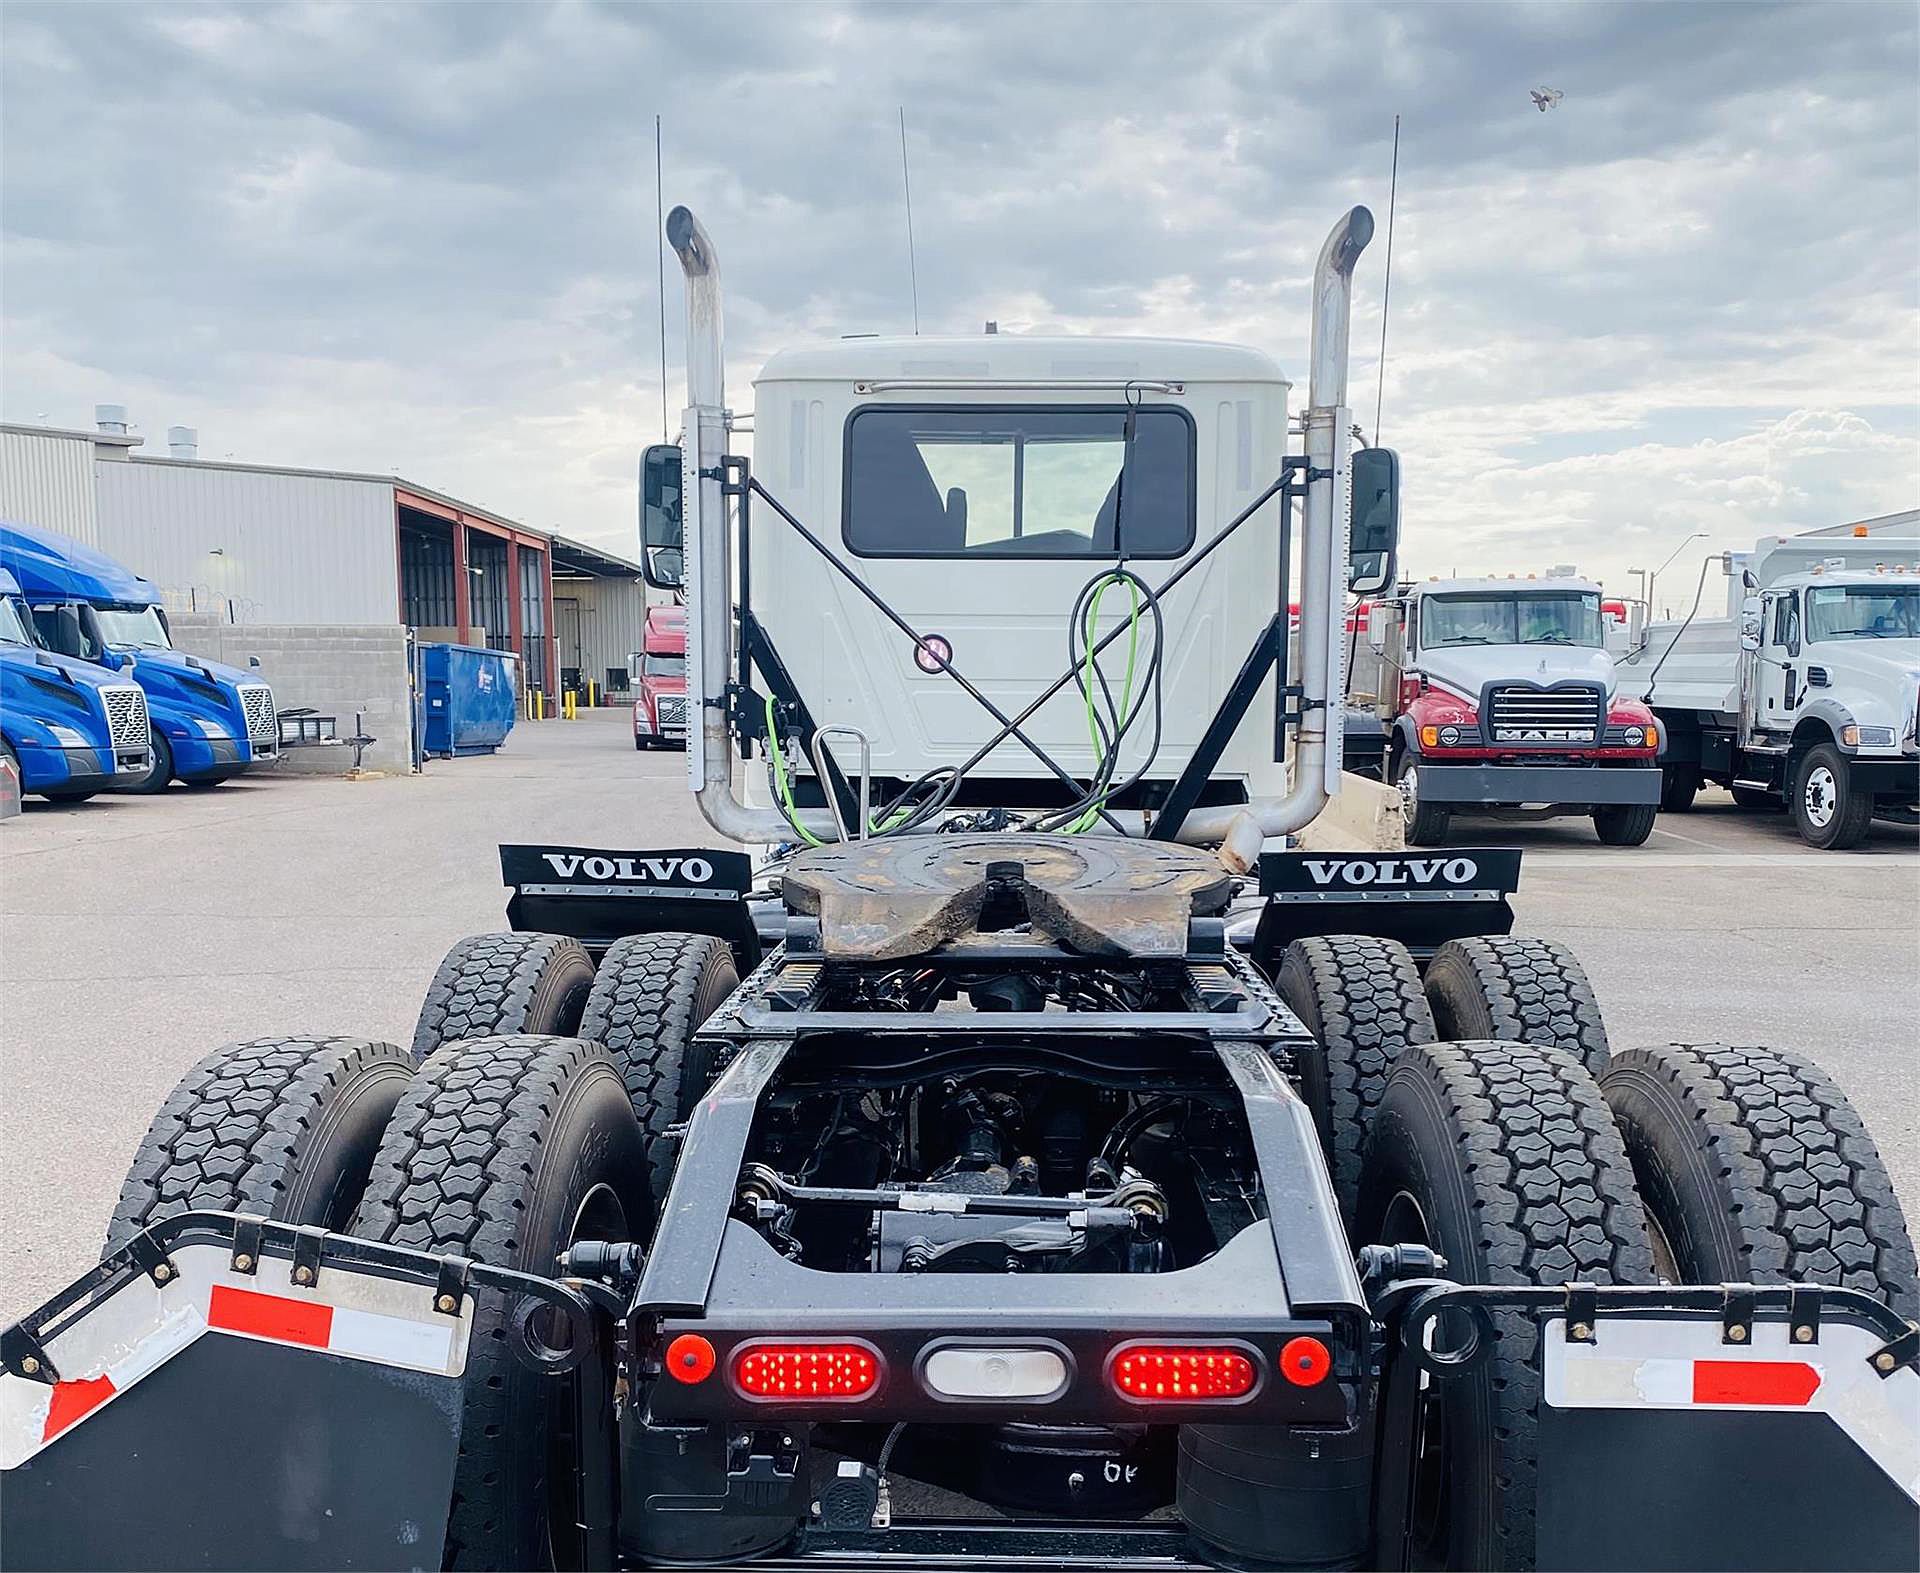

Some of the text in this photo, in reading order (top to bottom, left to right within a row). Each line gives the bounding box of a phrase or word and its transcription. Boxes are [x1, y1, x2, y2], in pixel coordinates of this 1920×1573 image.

[542, 854, 713, 883] VOLVO
[1302, 858, 1478, 885] VOLVO
[1104, 1460, 1138, 1483] OK
